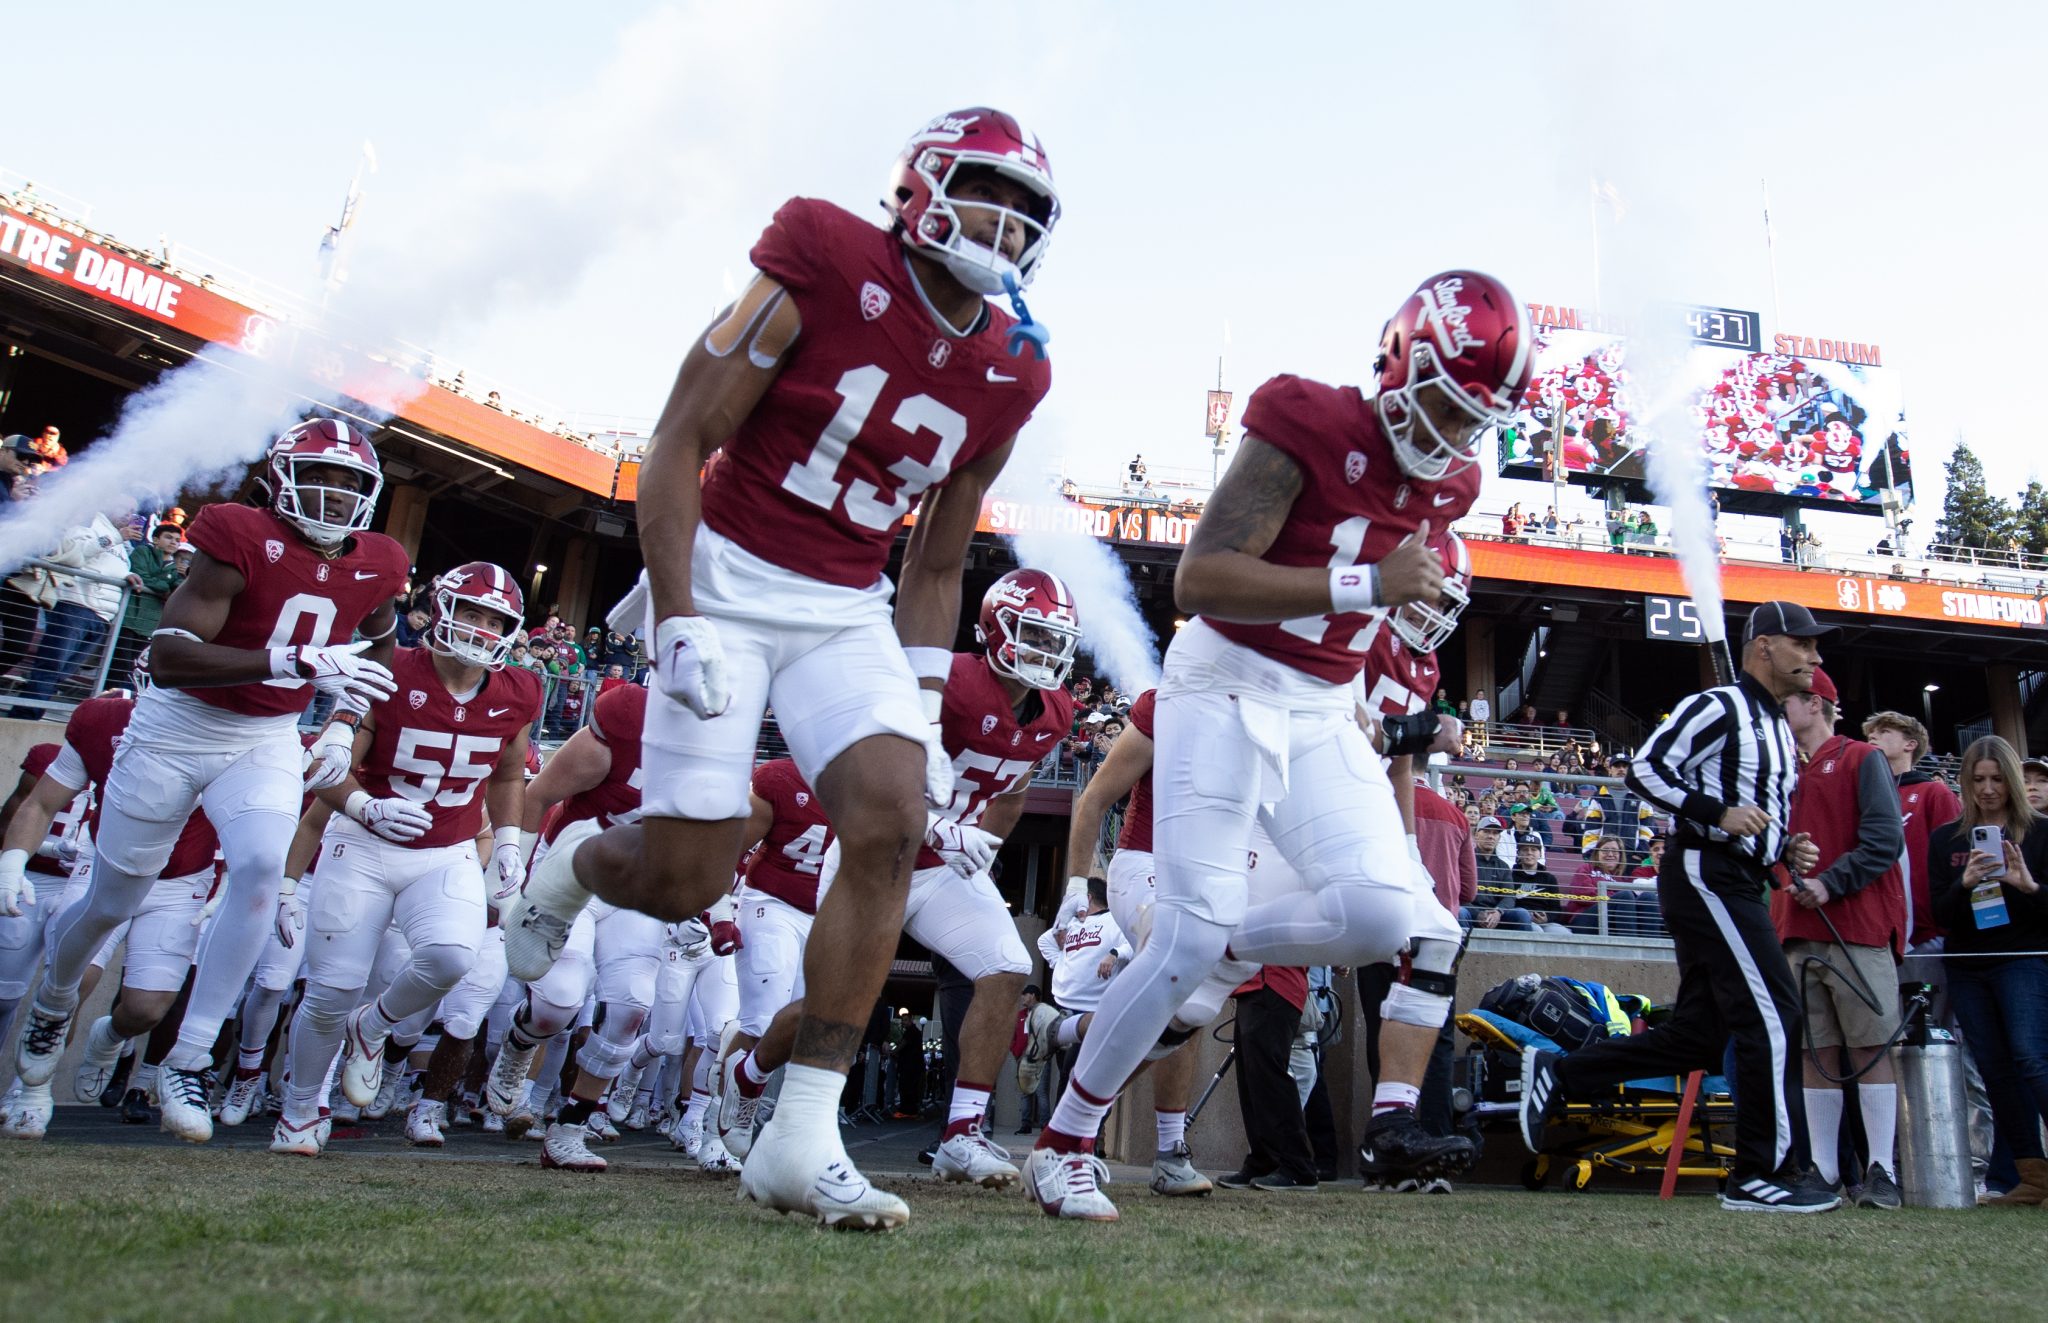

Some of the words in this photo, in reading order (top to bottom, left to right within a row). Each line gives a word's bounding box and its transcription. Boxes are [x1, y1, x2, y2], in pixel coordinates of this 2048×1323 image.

[0, 214, 71, 274] TRE
[73, 247, 182, 319] DAME
[1426, 277, 1486, 350] Stanford
[1686, 312, 1744, 342] 4:37
[1774, 333, 1882, 366] STADIUM
[781, 364, 968, 532] 13
[991, 502, 1110, 537] STANFORD
[1118, 511, 1142, 541] VS
[1650, 598, 1701, 639] 25
[1942, 591, 2042, 625] STANFORD
[265, 592, 338, 690] 0
[388, 727, 502, 808] 55
[948, 748, 1035, 826] 57
[782, 824, 828, 876] 4
[1065, 926, 1103, 945] tanford
